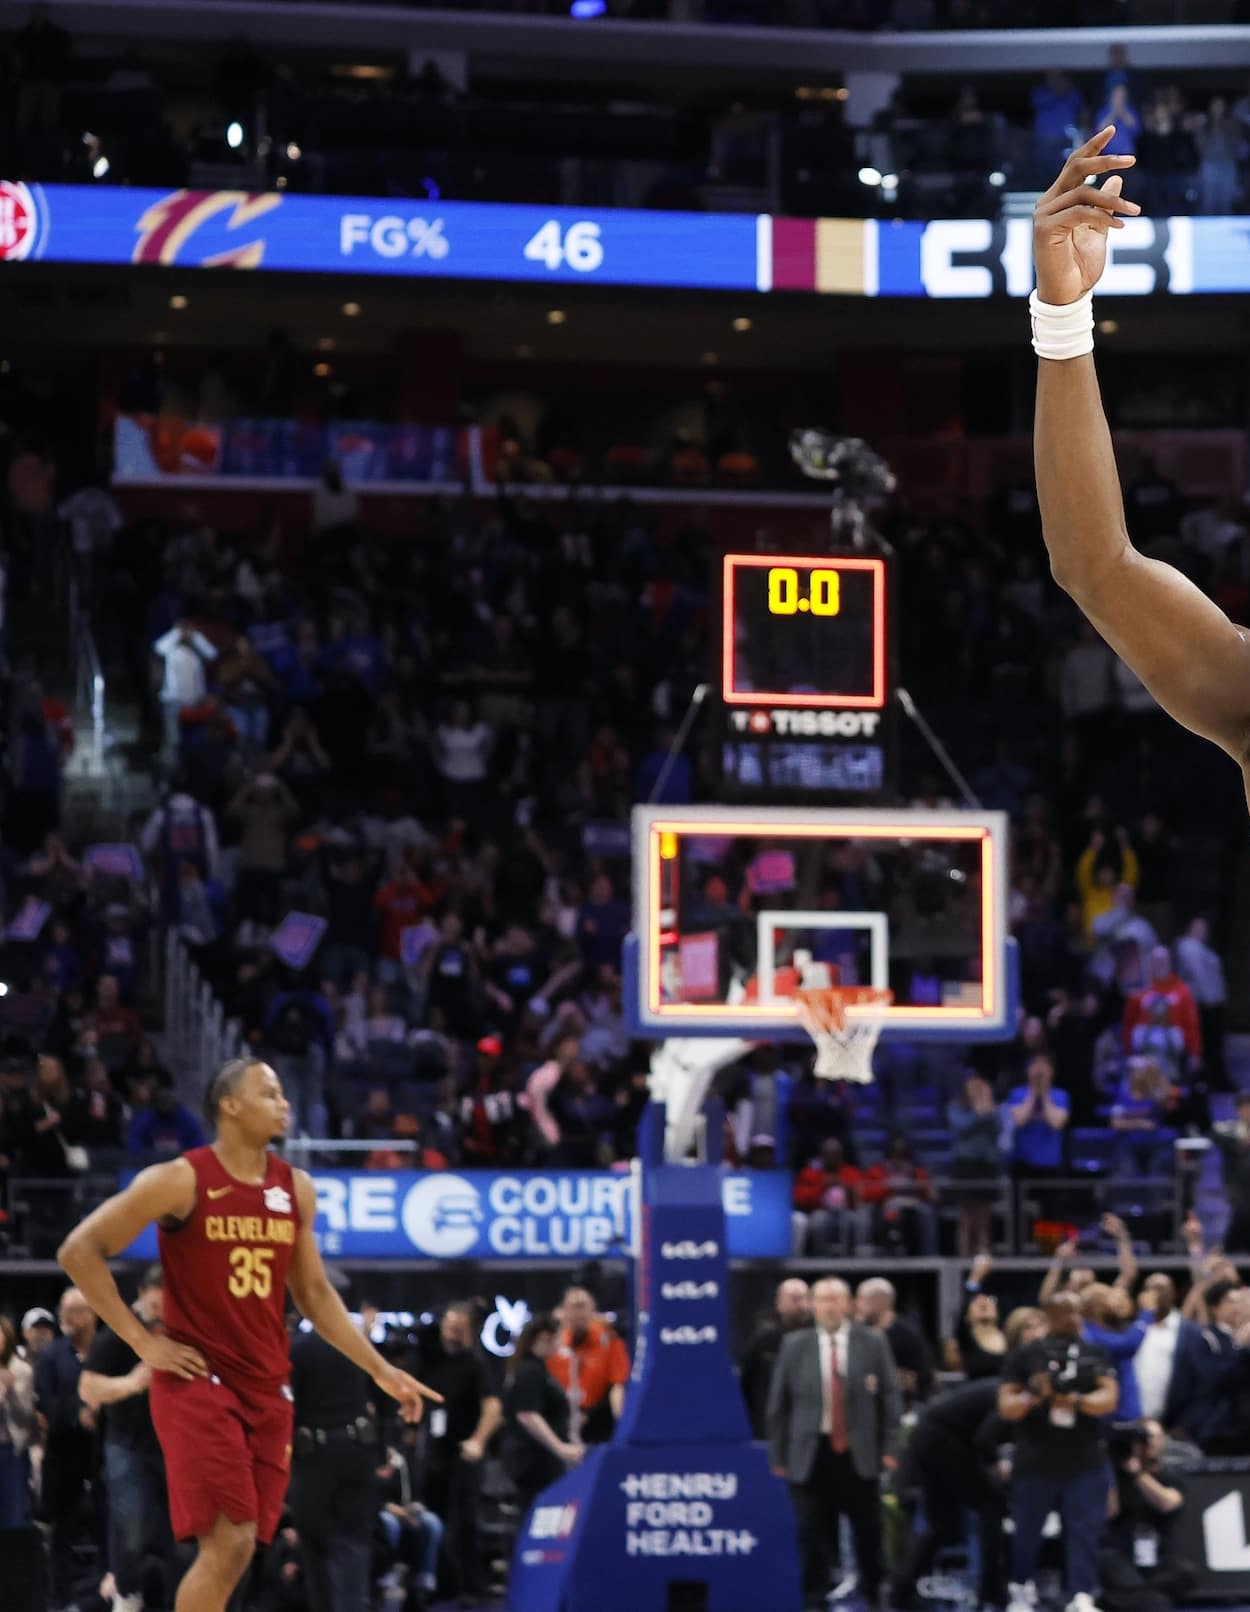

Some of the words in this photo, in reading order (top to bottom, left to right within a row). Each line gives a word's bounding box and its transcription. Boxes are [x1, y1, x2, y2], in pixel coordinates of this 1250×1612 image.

[340, 215, 449, 260] FG%
[524, 220, 604, 271] 46
[768, 567, 840, 616] 0.0
[771, 709, 880, 737] TISSOT
[205, 1215, 295, 1244] CLEVELAND
[488, 1216, 612, 1256] CLUB
[228, 1246, 275, 1298] 35
[625, 1501, 713, 1527] FORD
